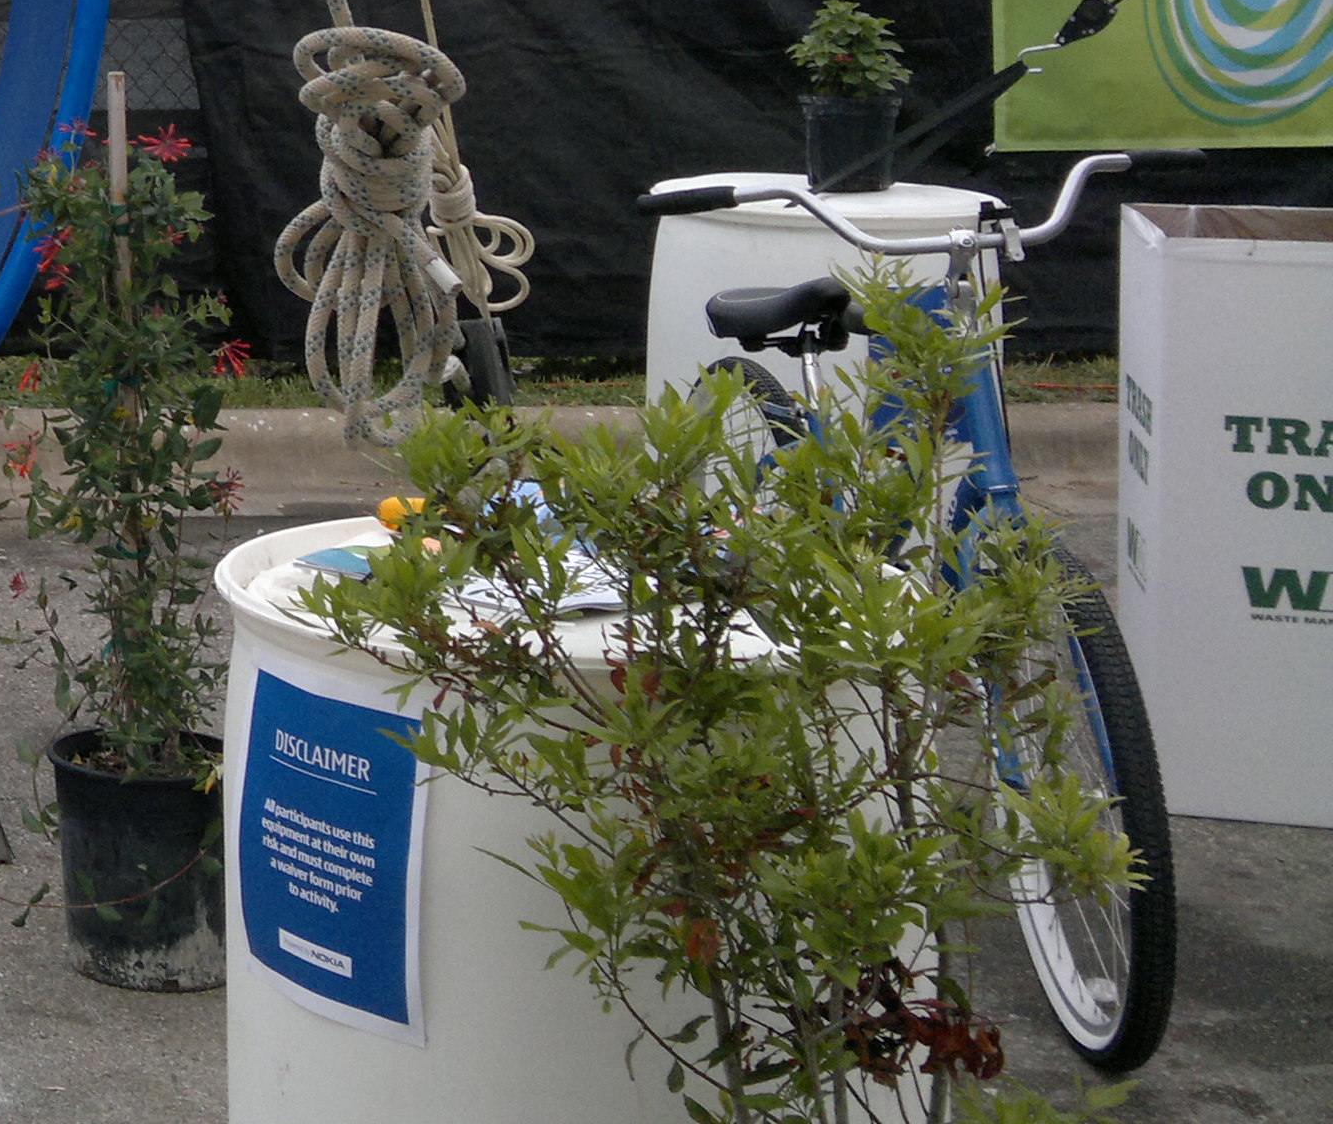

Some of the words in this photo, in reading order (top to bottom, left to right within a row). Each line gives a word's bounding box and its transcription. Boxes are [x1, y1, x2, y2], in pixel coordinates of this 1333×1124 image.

[1126, 373, 1152, 437] TRASH
[1129, 429, 1149, 486] ONLY
[1241, 566, 1333, 611] W
[1251, 613, 1299, 624] WASTE
[275, 728, 371, 782] DISCLAIMER
[262, 817, 310, 846] equipment
[311, 837, 322, 851] at
[323, 839, 349, 859] their
[349, 852, 375, 868] own
[264, 798, 276, 813] All
[275, 804, 331, 835] participants
[332, 826, 351, 842] use
[353, 831, 375, 849] this
[262, 834, 279, 851] risk
[279, 842, 297, 859] and
[298, 850, 323, 869] must
[324, 861, 373, 887] complete
[270, 857, 277, 869] a
[277, 860, 308, 882] waiver
[309, 871, 334, 892] form
[335, 882, 363, 902] prior
[289, 881, 299, 896] to
[300, 888, 339, 913] activity.
[311, 950, 345, 969] NOKIA
